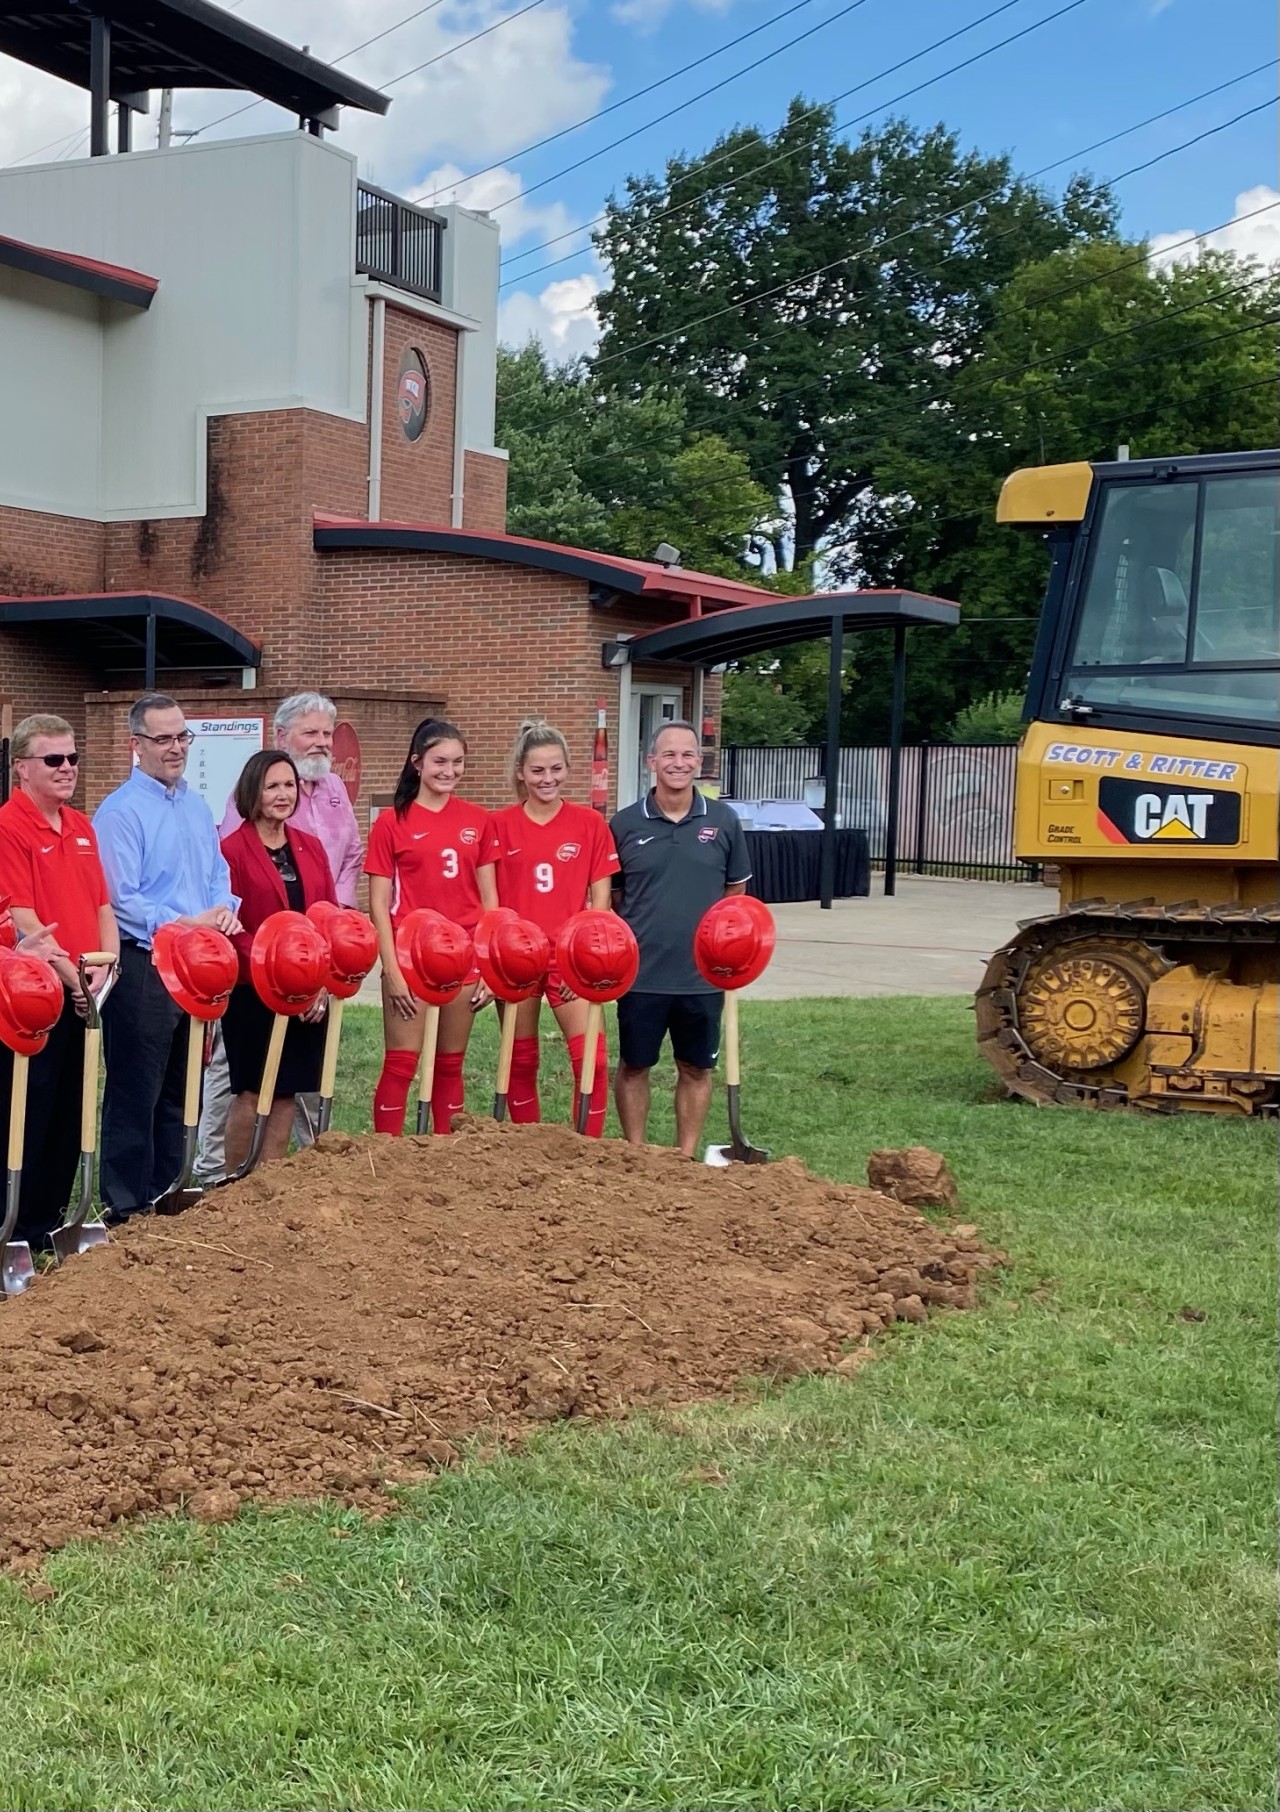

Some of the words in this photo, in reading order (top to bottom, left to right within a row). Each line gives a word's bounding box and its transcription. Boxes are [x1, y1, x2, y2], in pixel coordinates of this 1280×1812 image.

[201, 721, 259, 733] Standings
[1047, 745, 1121, 768] SCOTT
[1125, 754, 1142, 770] &
[1149, 756, 1238, 780] RITTER
[1134, 794, 1214, 839] CAT
[441, 848, 459, 879] 3
[536, 863, 553, 893] 9
